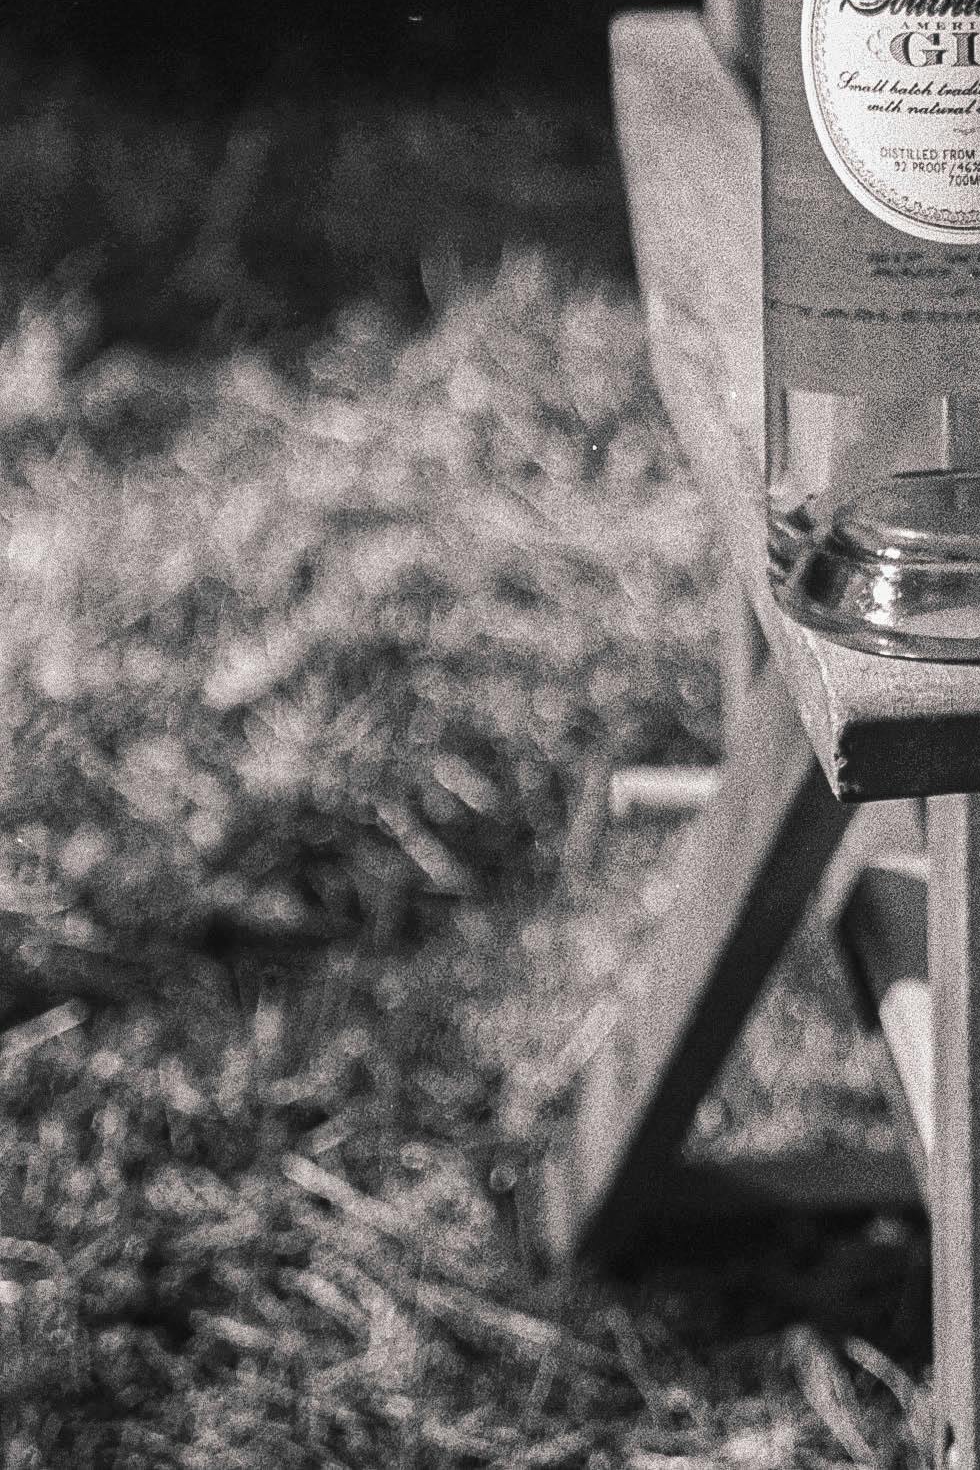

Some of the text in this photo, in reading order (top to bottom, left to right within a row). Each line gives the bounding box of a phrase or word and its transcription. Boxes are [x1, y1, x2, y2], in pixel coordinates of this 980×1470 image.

[837, 70, 889, 93] Small
[889, 80, 932, 96] batch
[867, 99, 902, 113] with
[907, 98, 978, 115] natural
[880, 146, 939, 161] DISTILLED
[942, 148, 976, 161] FROM
